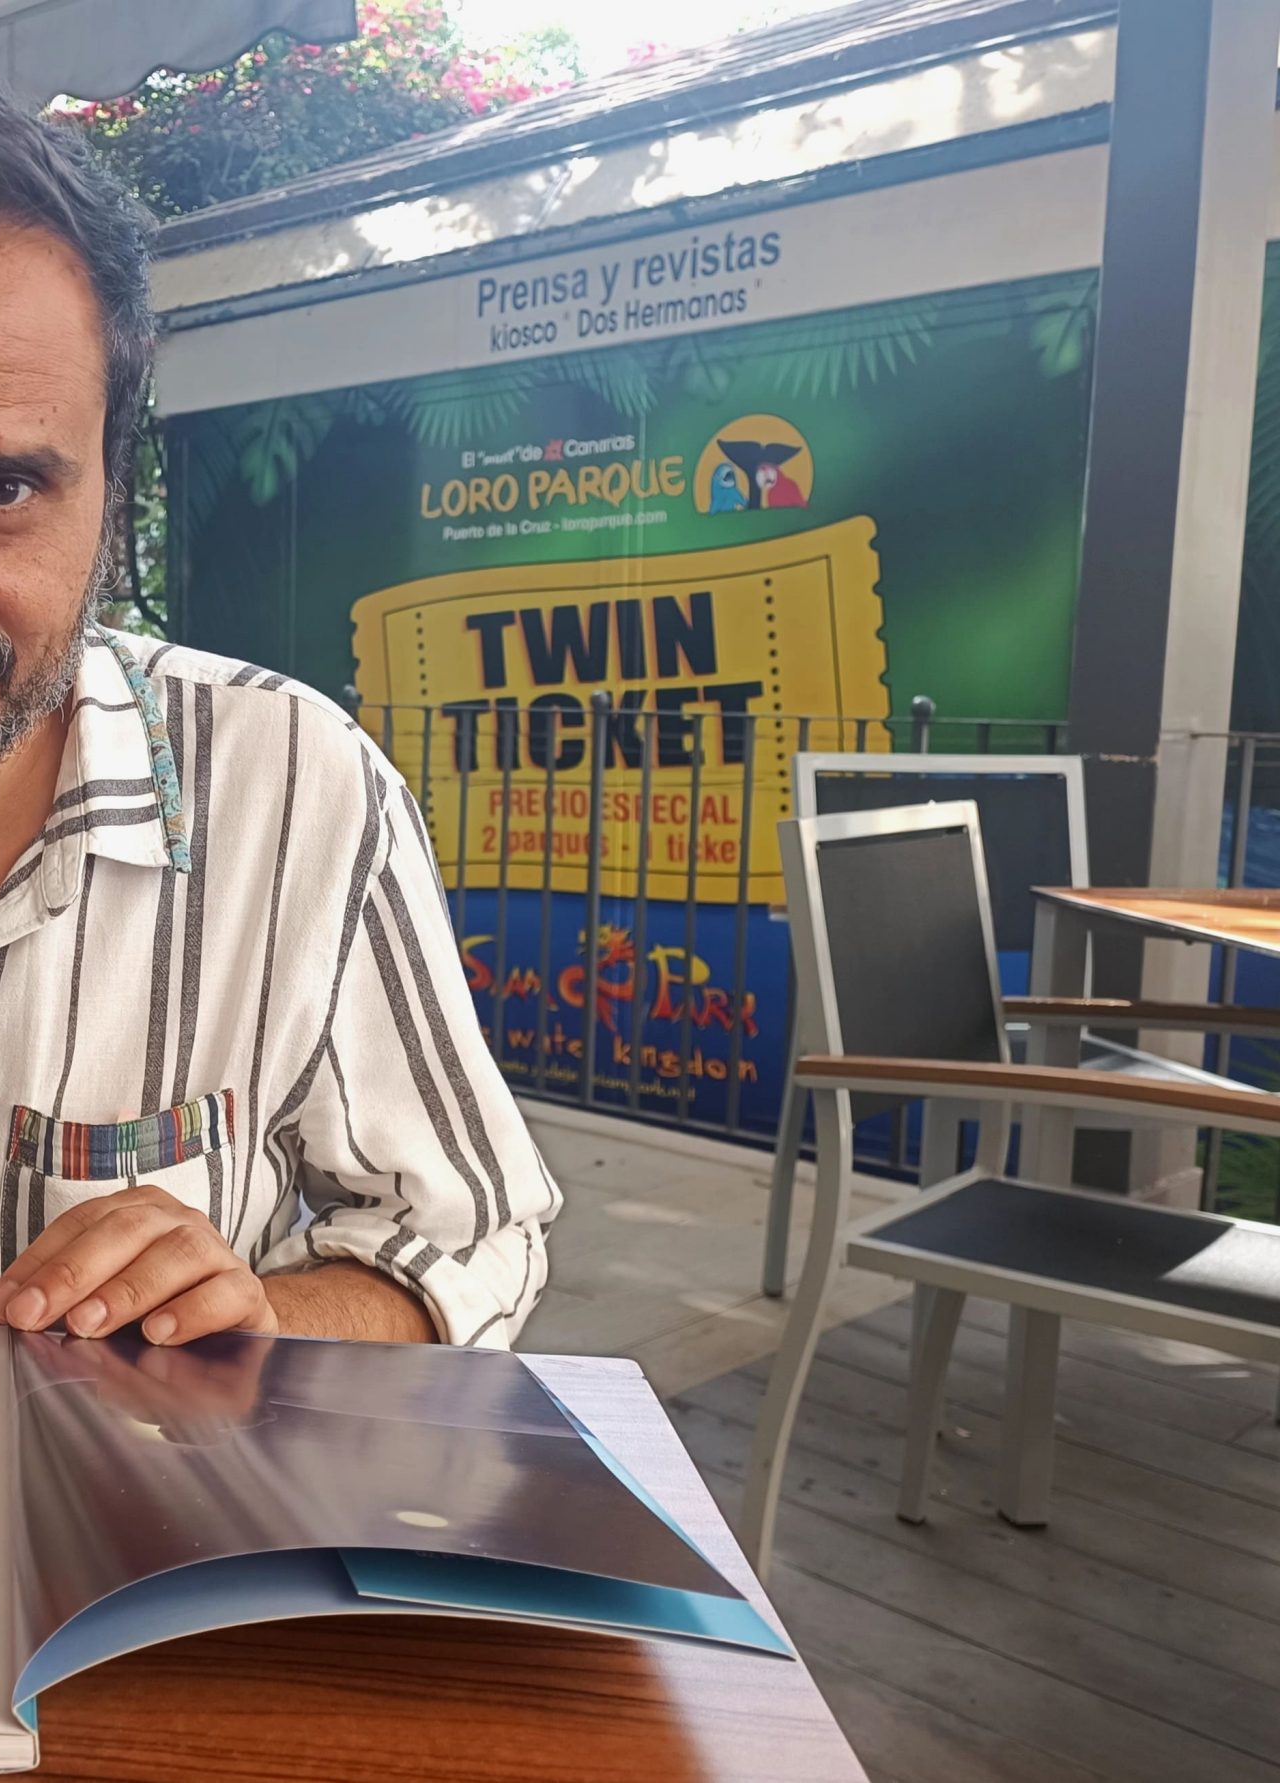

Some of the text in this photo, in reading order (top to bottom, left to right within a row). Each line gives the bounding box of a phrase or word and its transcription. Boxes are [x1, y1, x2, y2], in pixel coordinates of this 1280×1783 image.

[477, 230, 781, 318] Prensa y revistas
[490, 318, 558, 353] kiosco
[461, 450, 475, 469] El
[420, 455, 686, 519] LORO PARQUE
[442, 523, 485, 541] Puerto
[487, 520, 504, 537] de
[504, 520, 518, 536] la
[519, 518, 552, 536] Cruz
[465, 592, 718, 690] TWIN
[440, 681, 764, 773] TICKET
[481, 825, 497, 854] 2
